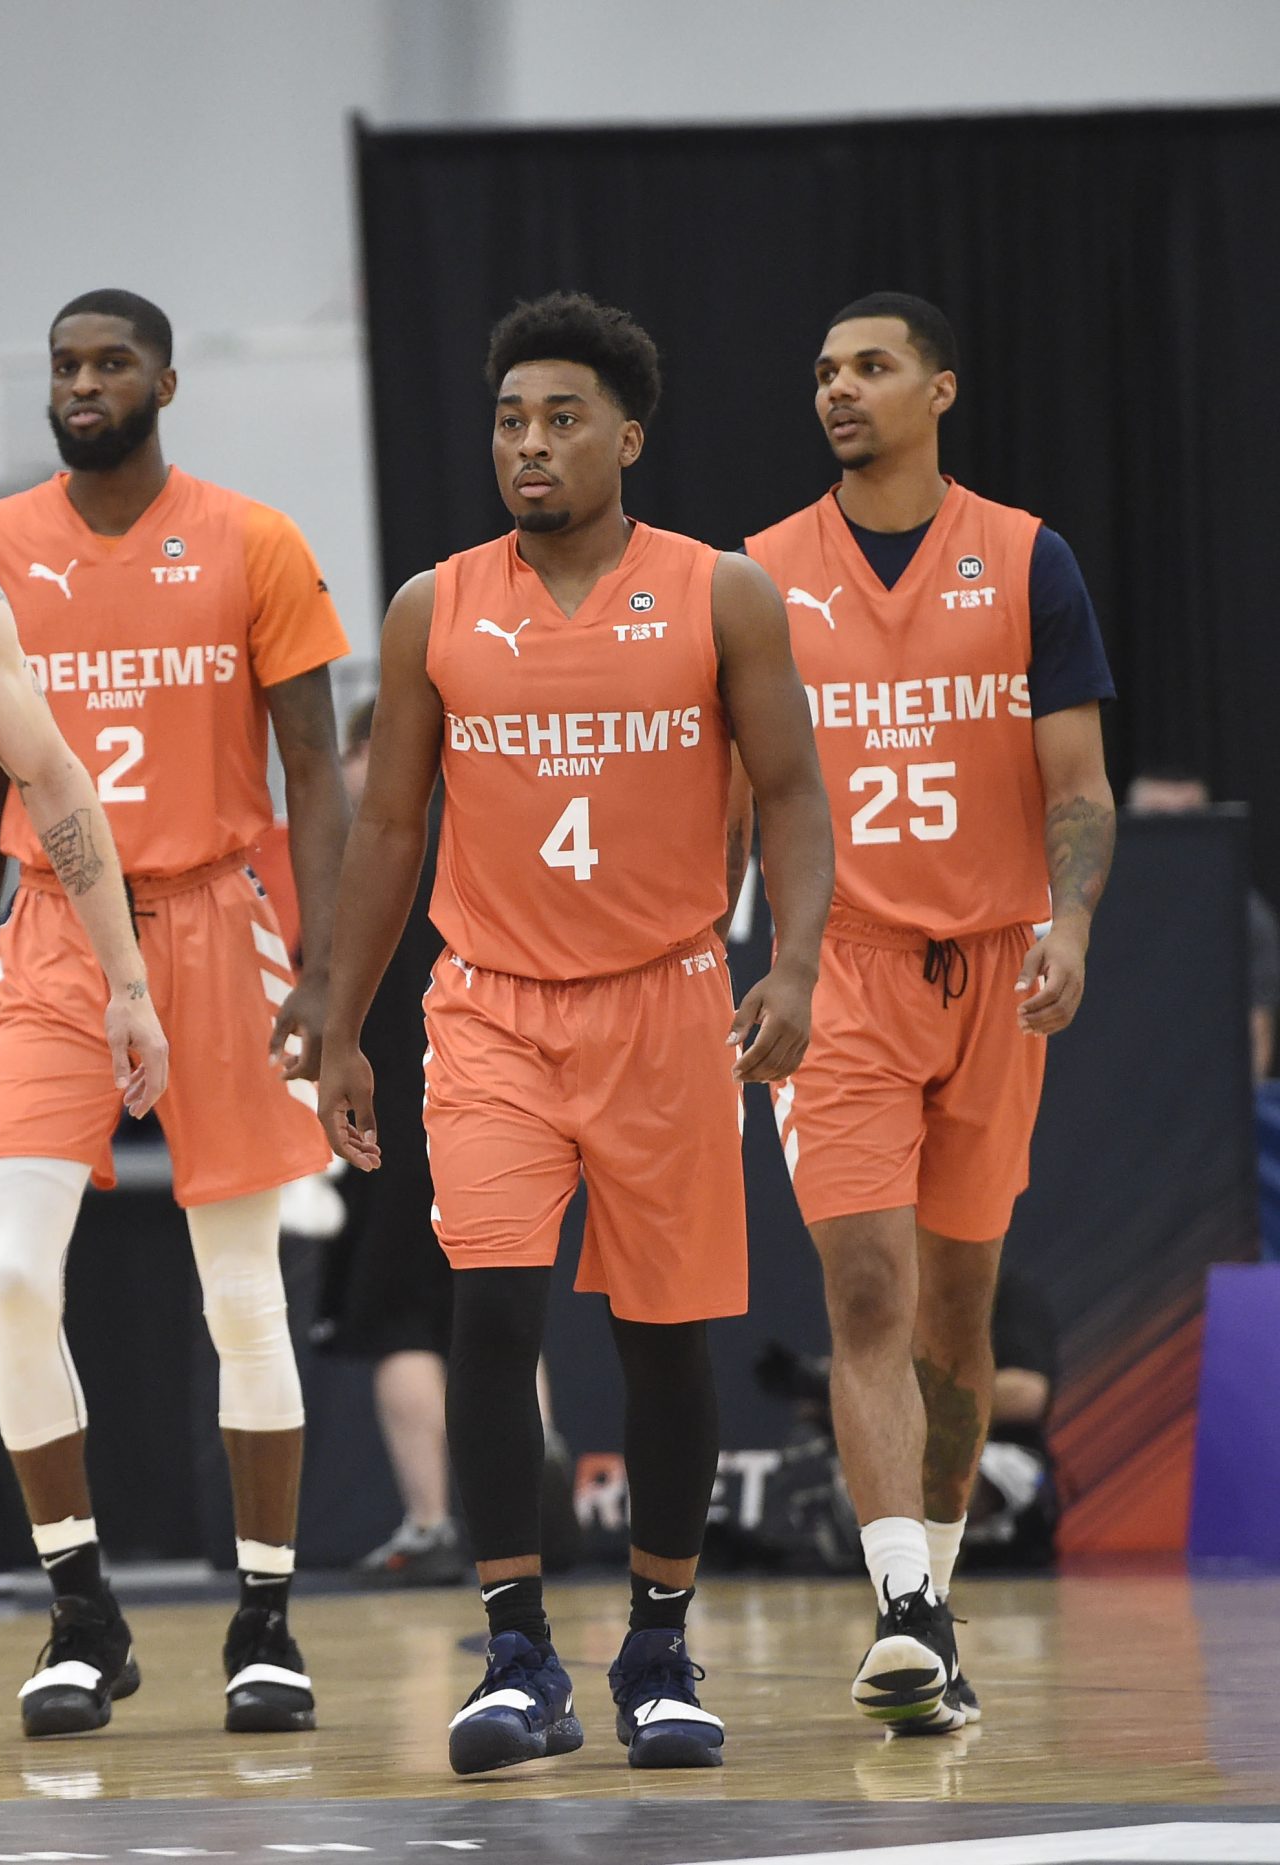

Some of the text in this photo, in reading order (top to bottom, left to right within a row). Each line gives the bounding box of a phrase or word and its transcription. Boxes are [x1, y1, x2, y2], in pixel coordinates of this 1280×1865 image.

[962, 561, 979, 575] DG
[633, 597, 651, 609] DG
[940, 586, 997, 610] TBT
[612, 621, 668, 642] TBT
[24, 644, 238, 693] OEHEIM'S
[86, 690, 146, 711] ARMY
[447, 705, 701, 755] BOEHEIM'S
[865, 726, 936, 749] ARMY
[95, 725, 147, 803] 2
[537, 757, 605, 777] ARMY
[848, 761, 958, 845] 25
[538, 796, 599, 881] 4
